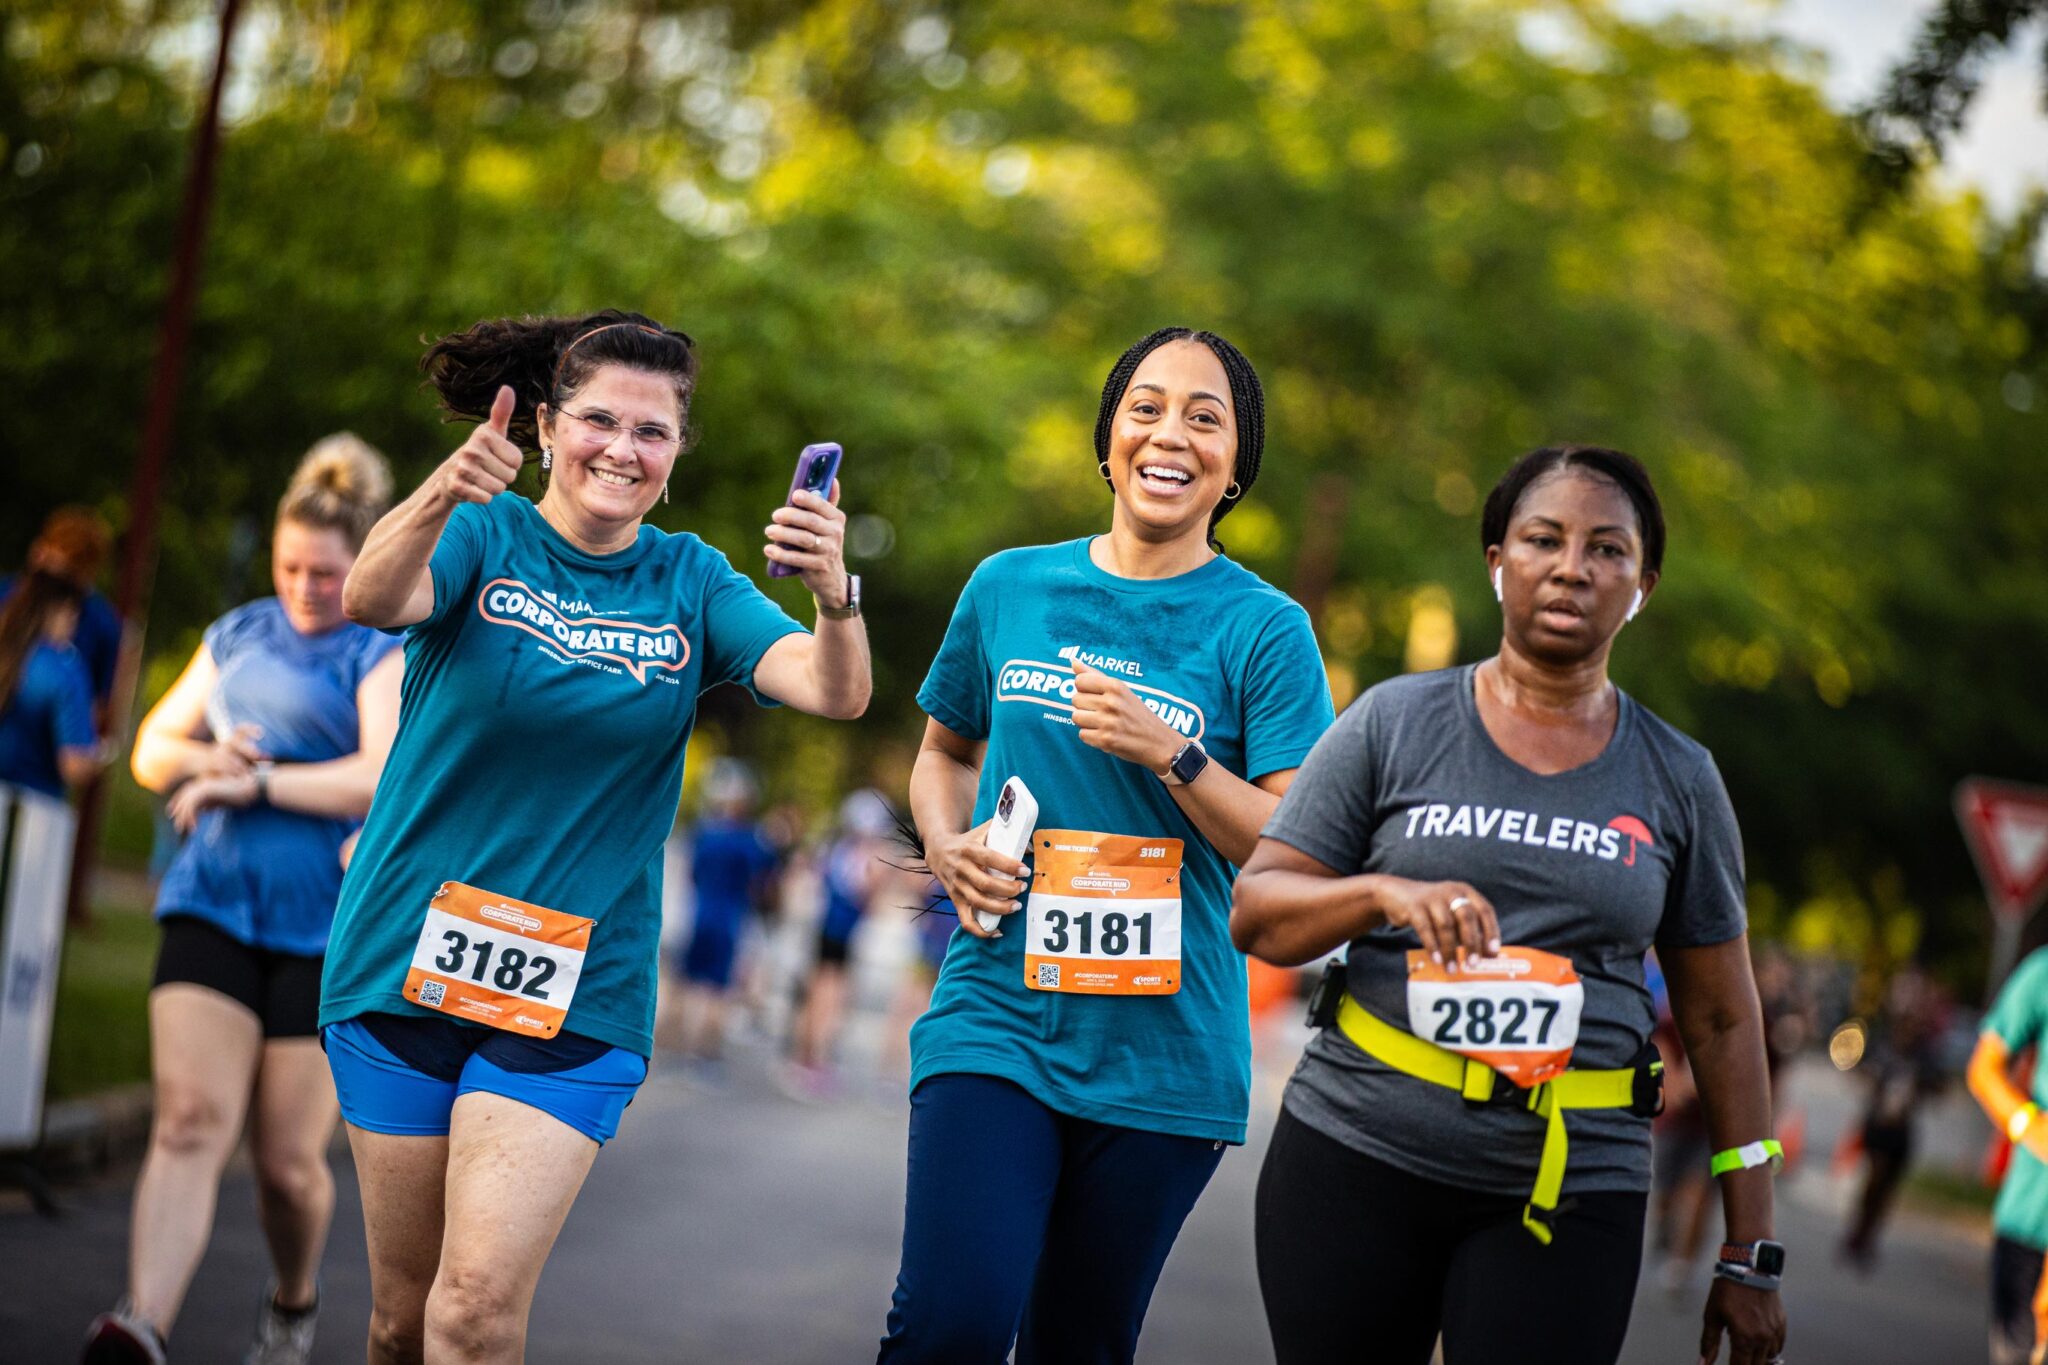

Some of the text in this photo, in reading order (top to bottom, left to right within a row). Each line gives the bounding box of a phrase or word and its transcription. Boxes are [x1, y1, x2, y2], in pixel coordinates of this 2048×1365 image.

[489, 589, 635, 654] CORPORATE
[577, 658, 602, 670] OFFICE
[602, 664, 623, 675] PARK
[1080, 651, 1144, 677] MARKEL
[1043, 712, 1076, 726] INNSBRO
[1405, 804, 1620, 861] TRAVELERS
[1139, 847, 1166, 858] 3181
[1074, 879, 1127, 889] CORPORATE RUN
[483, 908, 525, 925] CORPORATE
[1043, 909, 1152, 956] 3181
[435, 930, 557, 1000] 3182
[1432, 997, 1560, 1045] 2827
